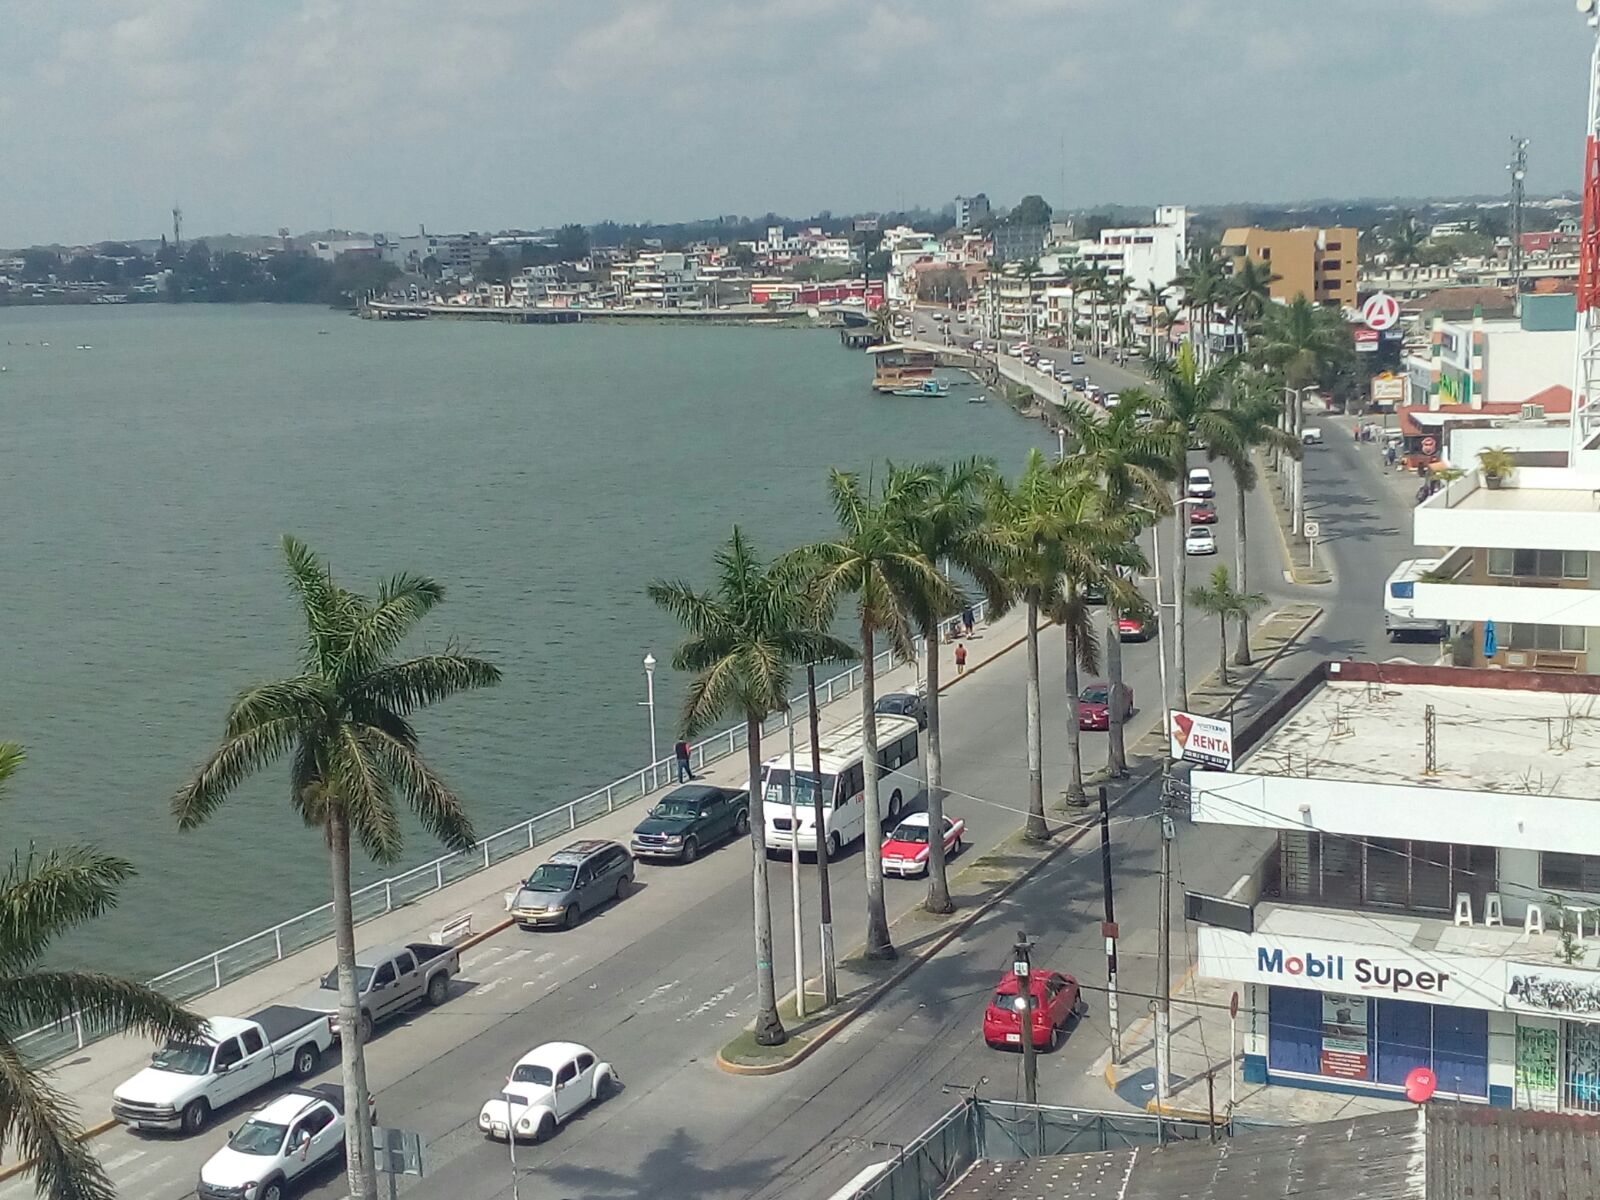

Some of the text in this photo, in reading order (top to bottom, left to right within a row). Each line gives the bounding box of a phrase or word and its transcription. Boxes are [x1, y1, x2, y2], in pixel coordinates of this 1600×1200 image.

[1192, 734, 1230, 754] RENTA
[1257, 947, 1450, 993] Mobil Super
